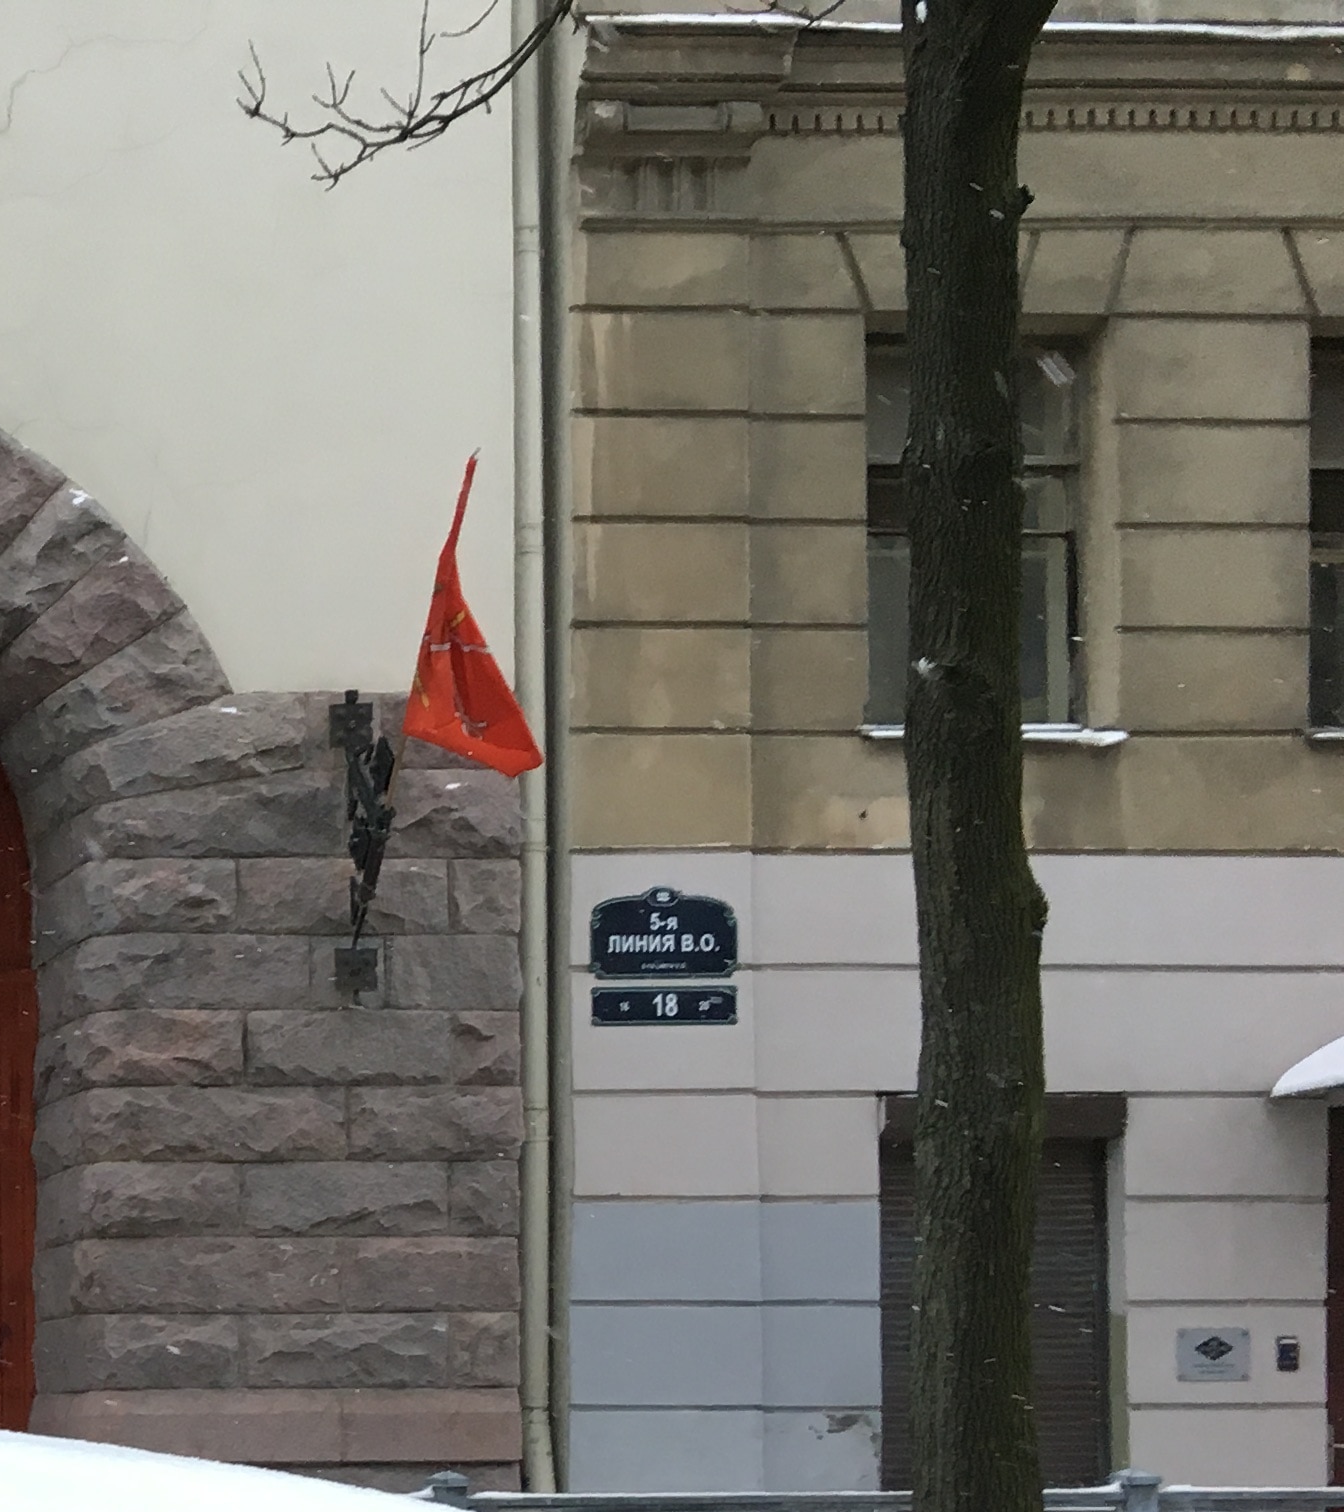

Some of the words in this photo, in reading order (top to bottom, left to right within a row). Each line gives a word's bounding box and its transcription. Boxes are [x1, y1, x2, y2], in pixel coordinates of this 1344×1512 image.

[649, 912, 679, 931] 5-я
[607, 934, 676, 953] ЛИНИЯ
[680, 933, 721, 953] В.О.
[652, 993, 679, 1017] 18
